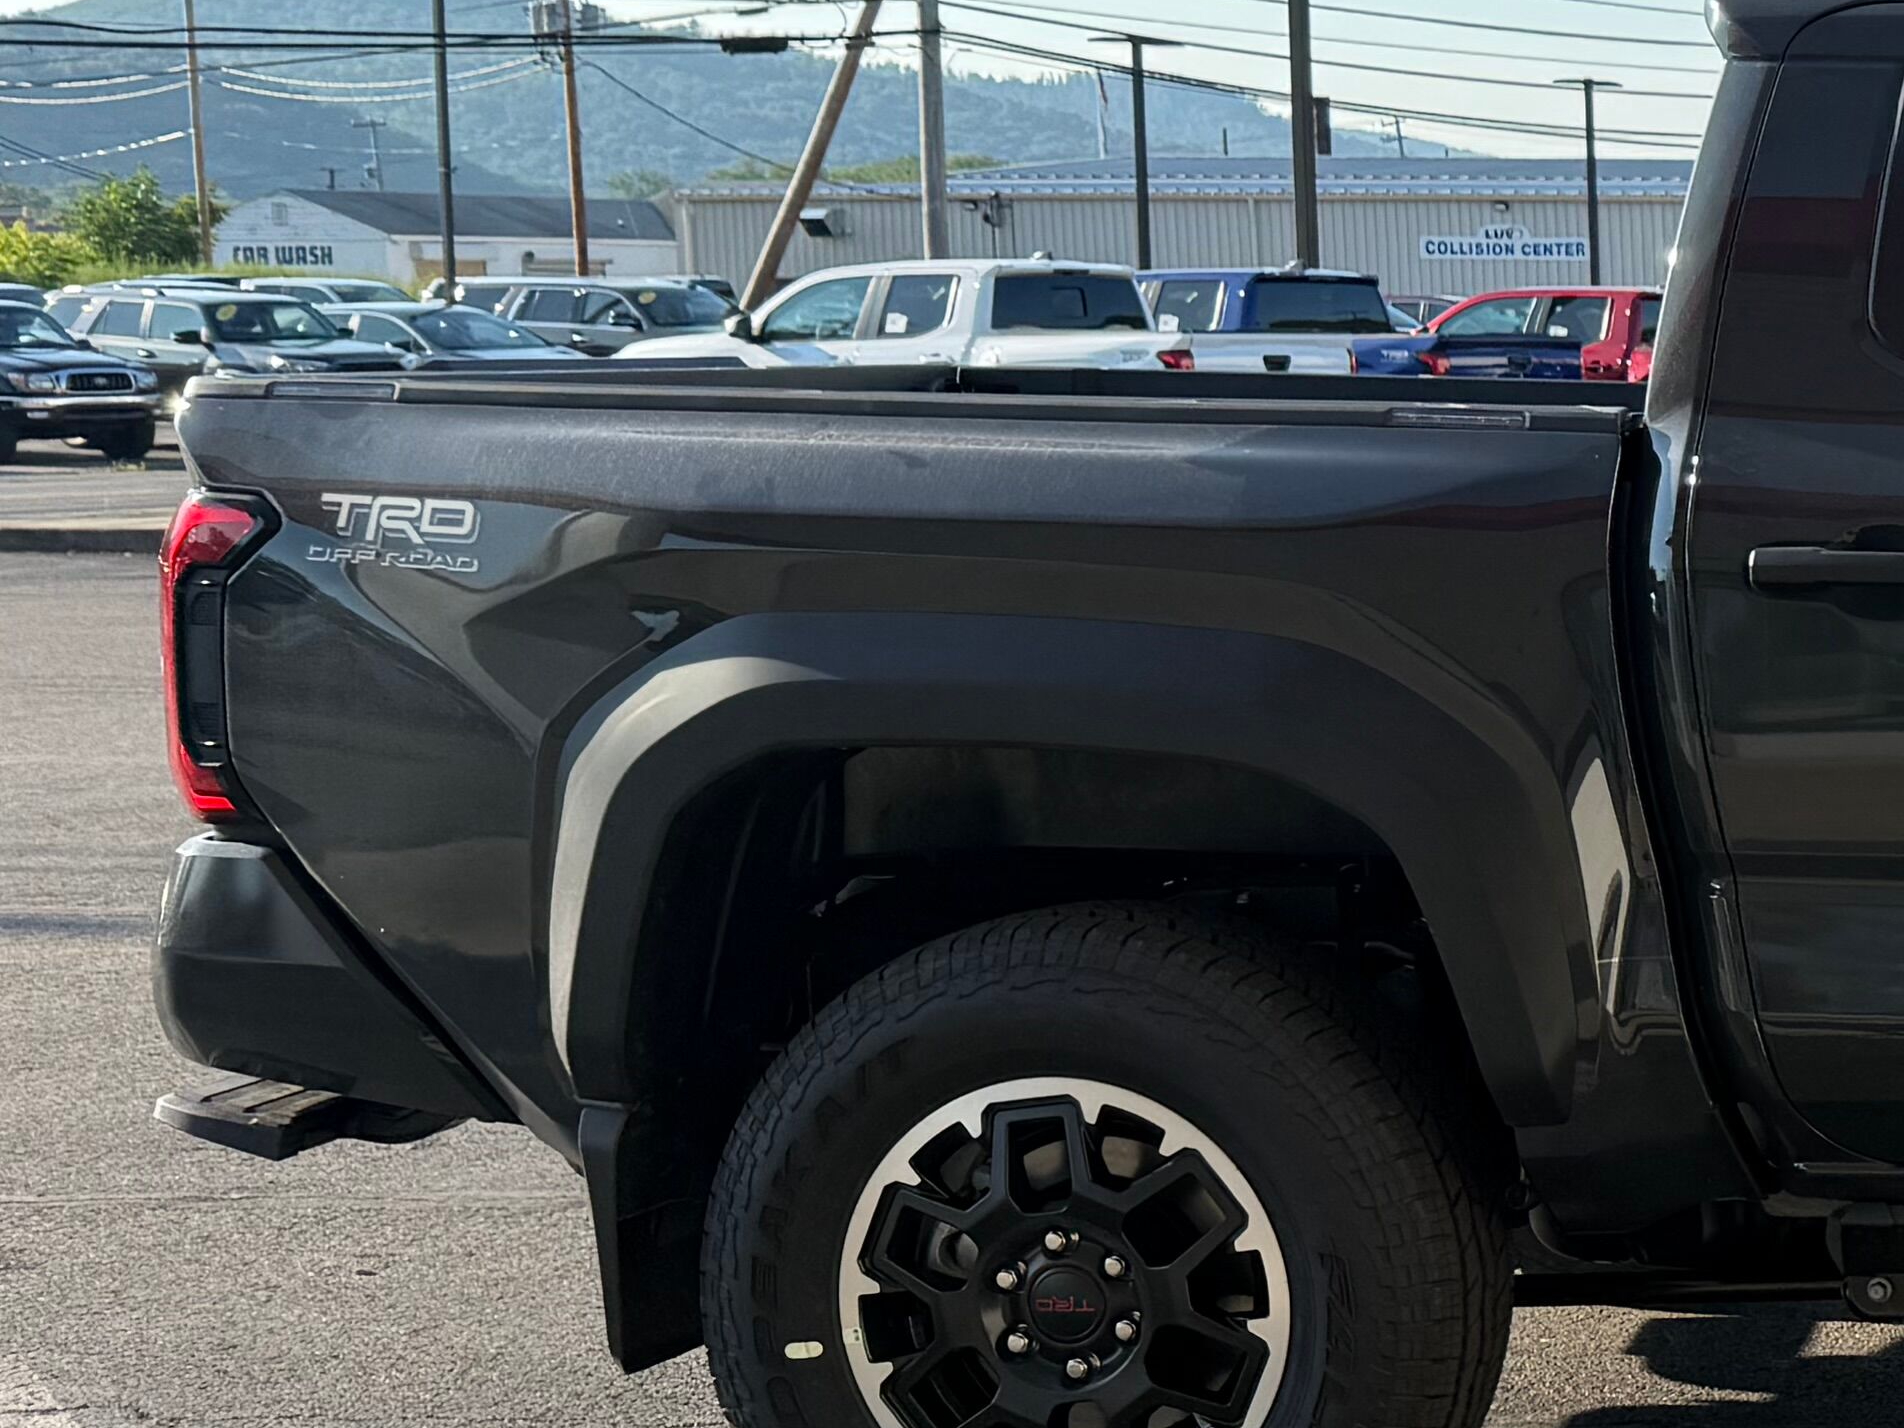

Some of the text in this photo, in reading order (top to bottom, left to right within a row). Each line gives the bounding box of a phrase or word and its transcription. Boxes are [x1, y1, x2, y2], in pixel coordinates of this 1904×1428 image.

[233, 245, 333, 266] CAR WASH
[1425, 240, 1586, 257] COLLISION CENTER
[321, 492, 480, 545] TRD
[305, 545, 479, 572] OFF ROAD
[1035, 1295, 1097, 1314] TRD
